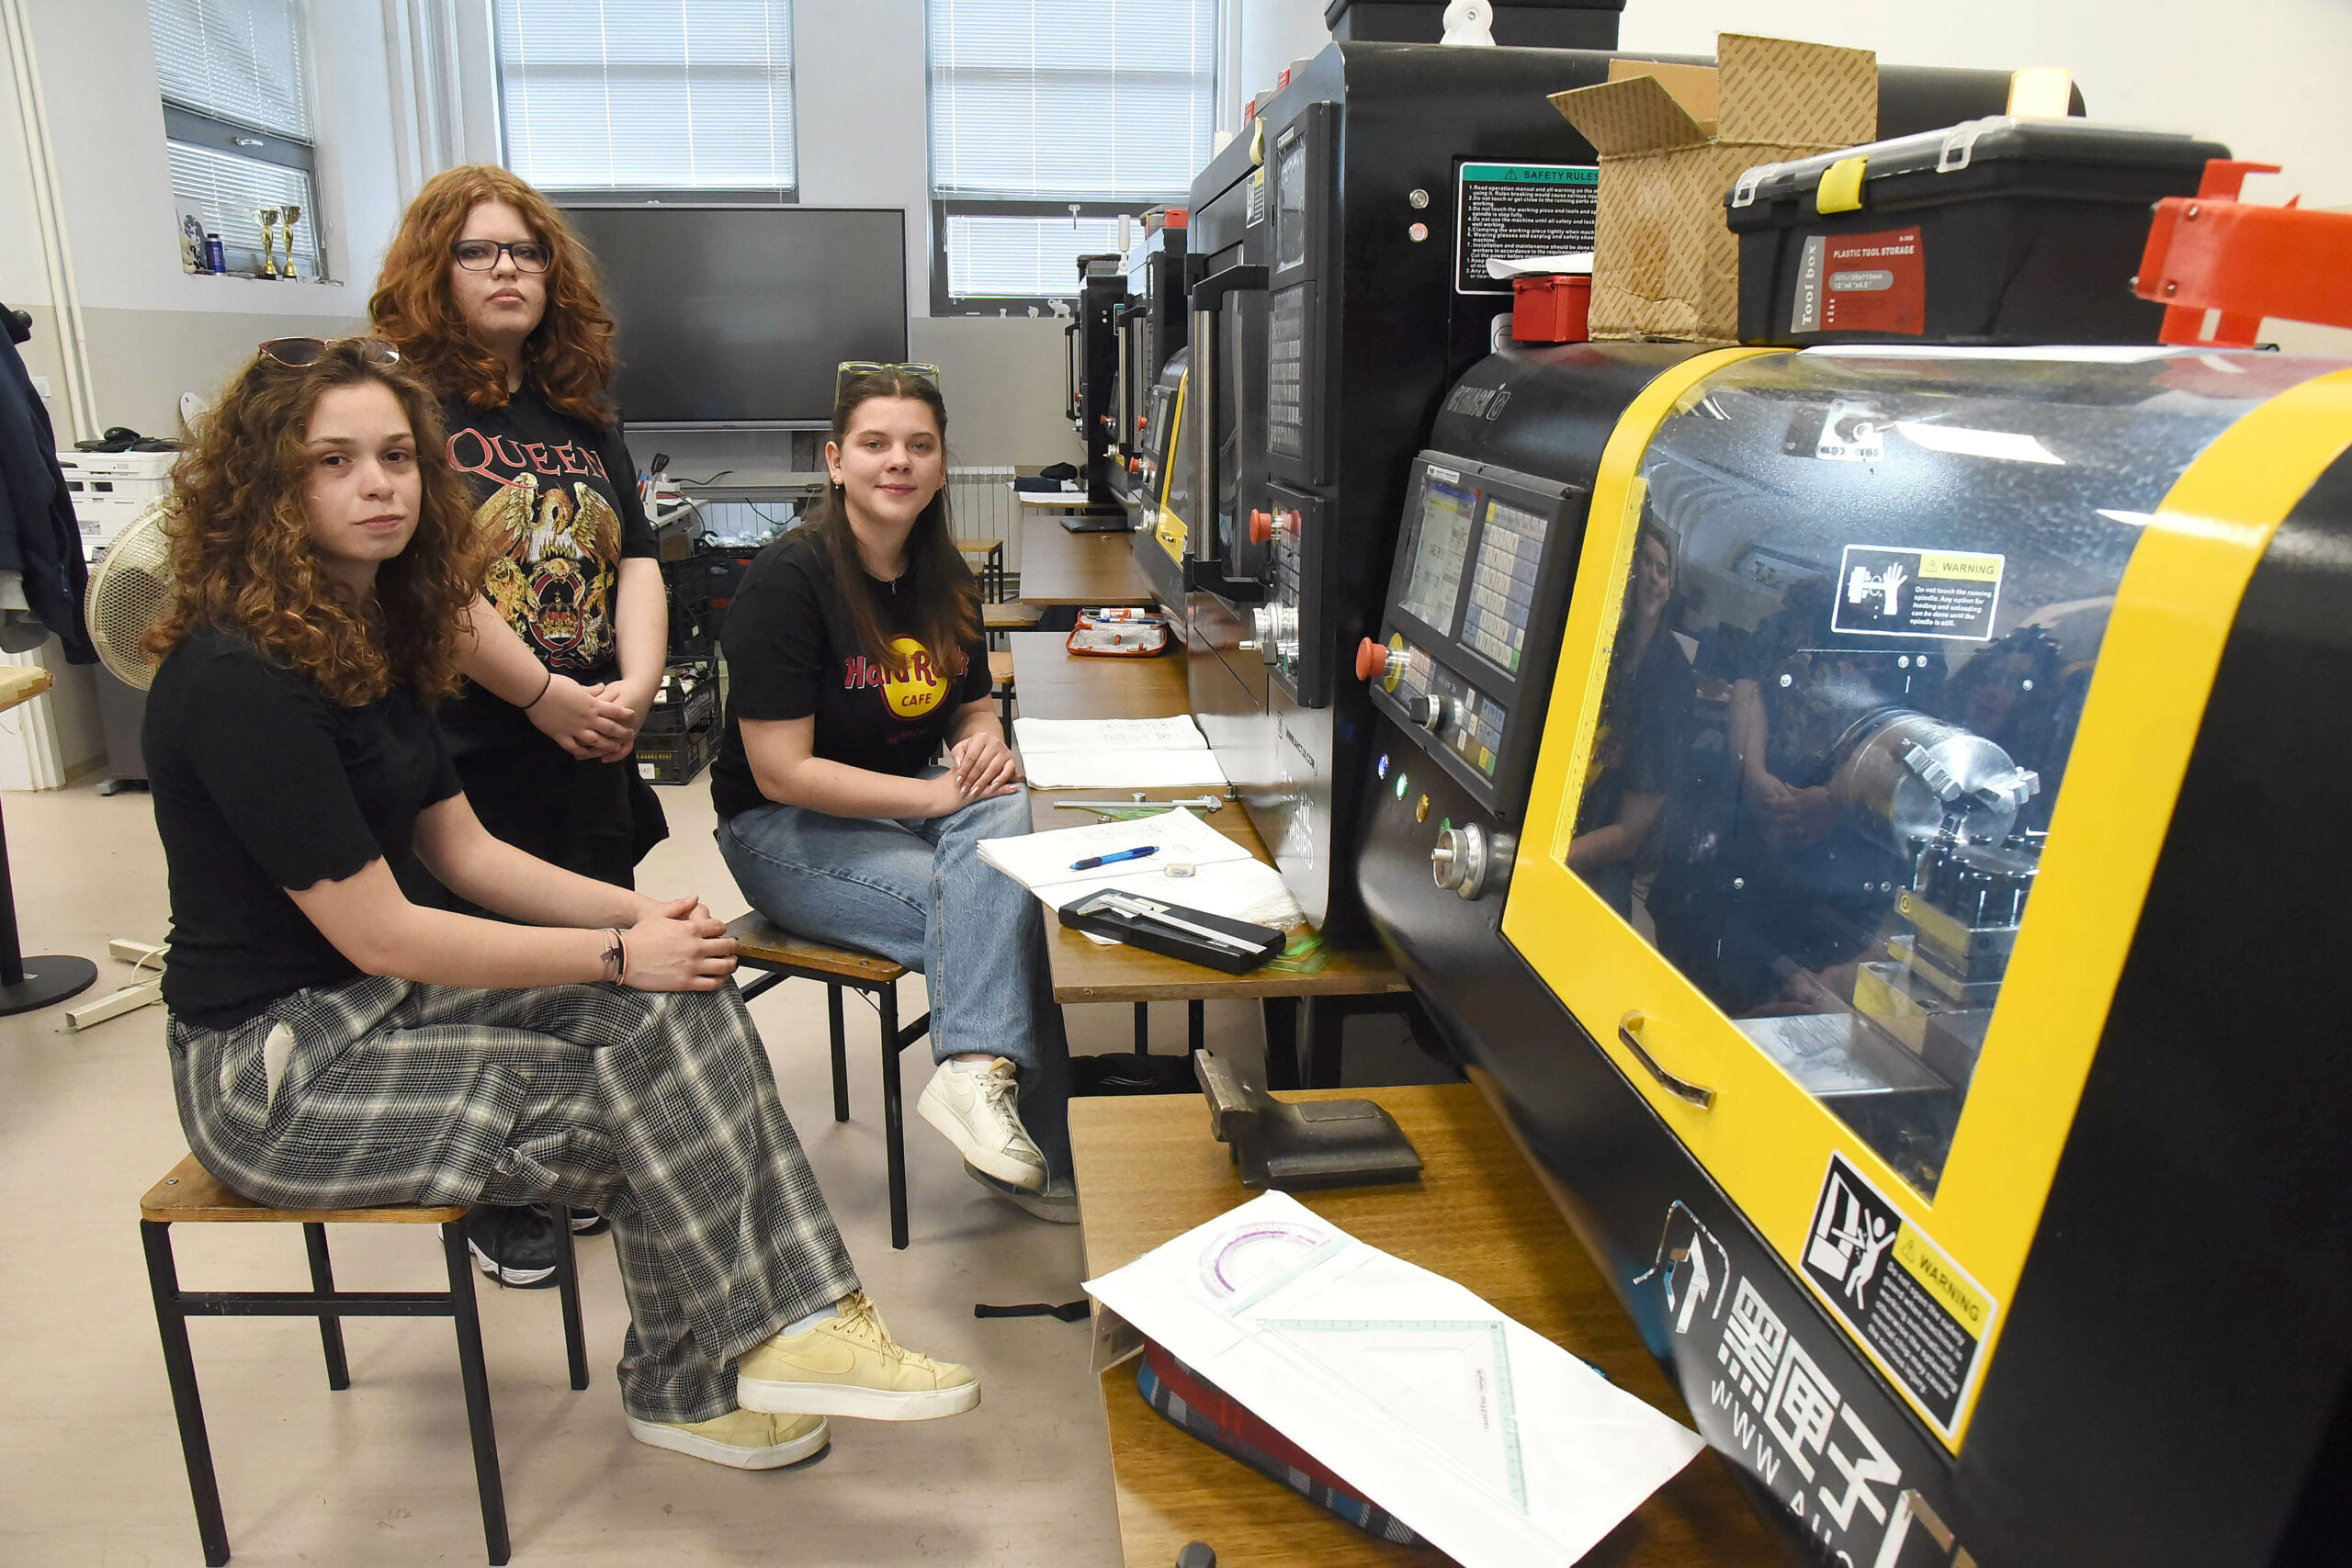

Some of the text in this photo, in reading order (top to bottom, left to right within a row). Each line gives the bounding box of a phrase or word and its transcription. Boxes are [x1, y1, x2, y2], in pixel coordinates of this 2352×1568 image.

[1524, 170, 1599, 181] SAFETY RULES
[1834, 245, 1915, 258] PLASTIC TOOL STORAGE
[1802, 245, 1816, 325] Tool box
[447, 428, 611, 490] QUEEN
[1943, 562, 1994, 574] WARNING
[901, 693, 932, 706] CAFE
[1919, 1255, 1979, 1322] WARNING
[1717, 1275, 1902, 1532] 黑匣子
